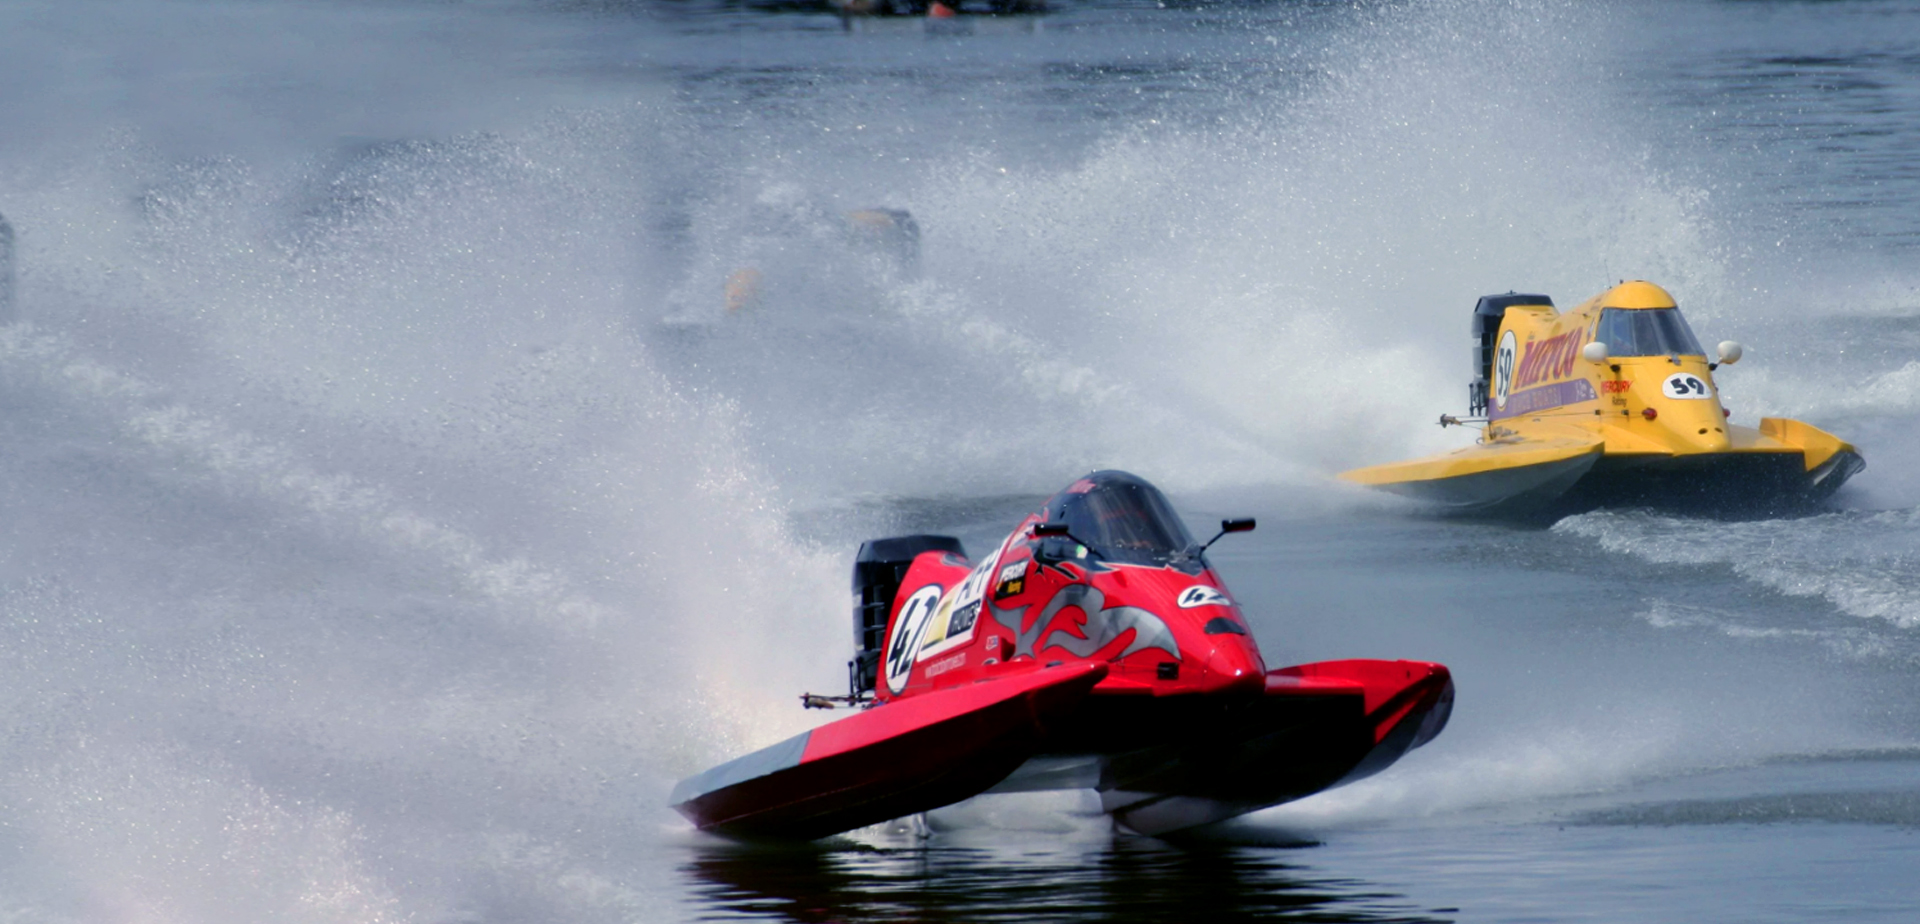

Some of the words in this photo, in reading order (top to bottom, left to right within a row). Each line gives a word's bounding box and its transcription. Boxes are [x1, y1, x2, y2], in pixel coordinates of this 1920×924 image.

[1498, 348, 1512, 397] 59
[1670, 378, 1705, 395] 59
[1182, 588, 1228, 605] 42
[888, 595, 939, 680] 42
